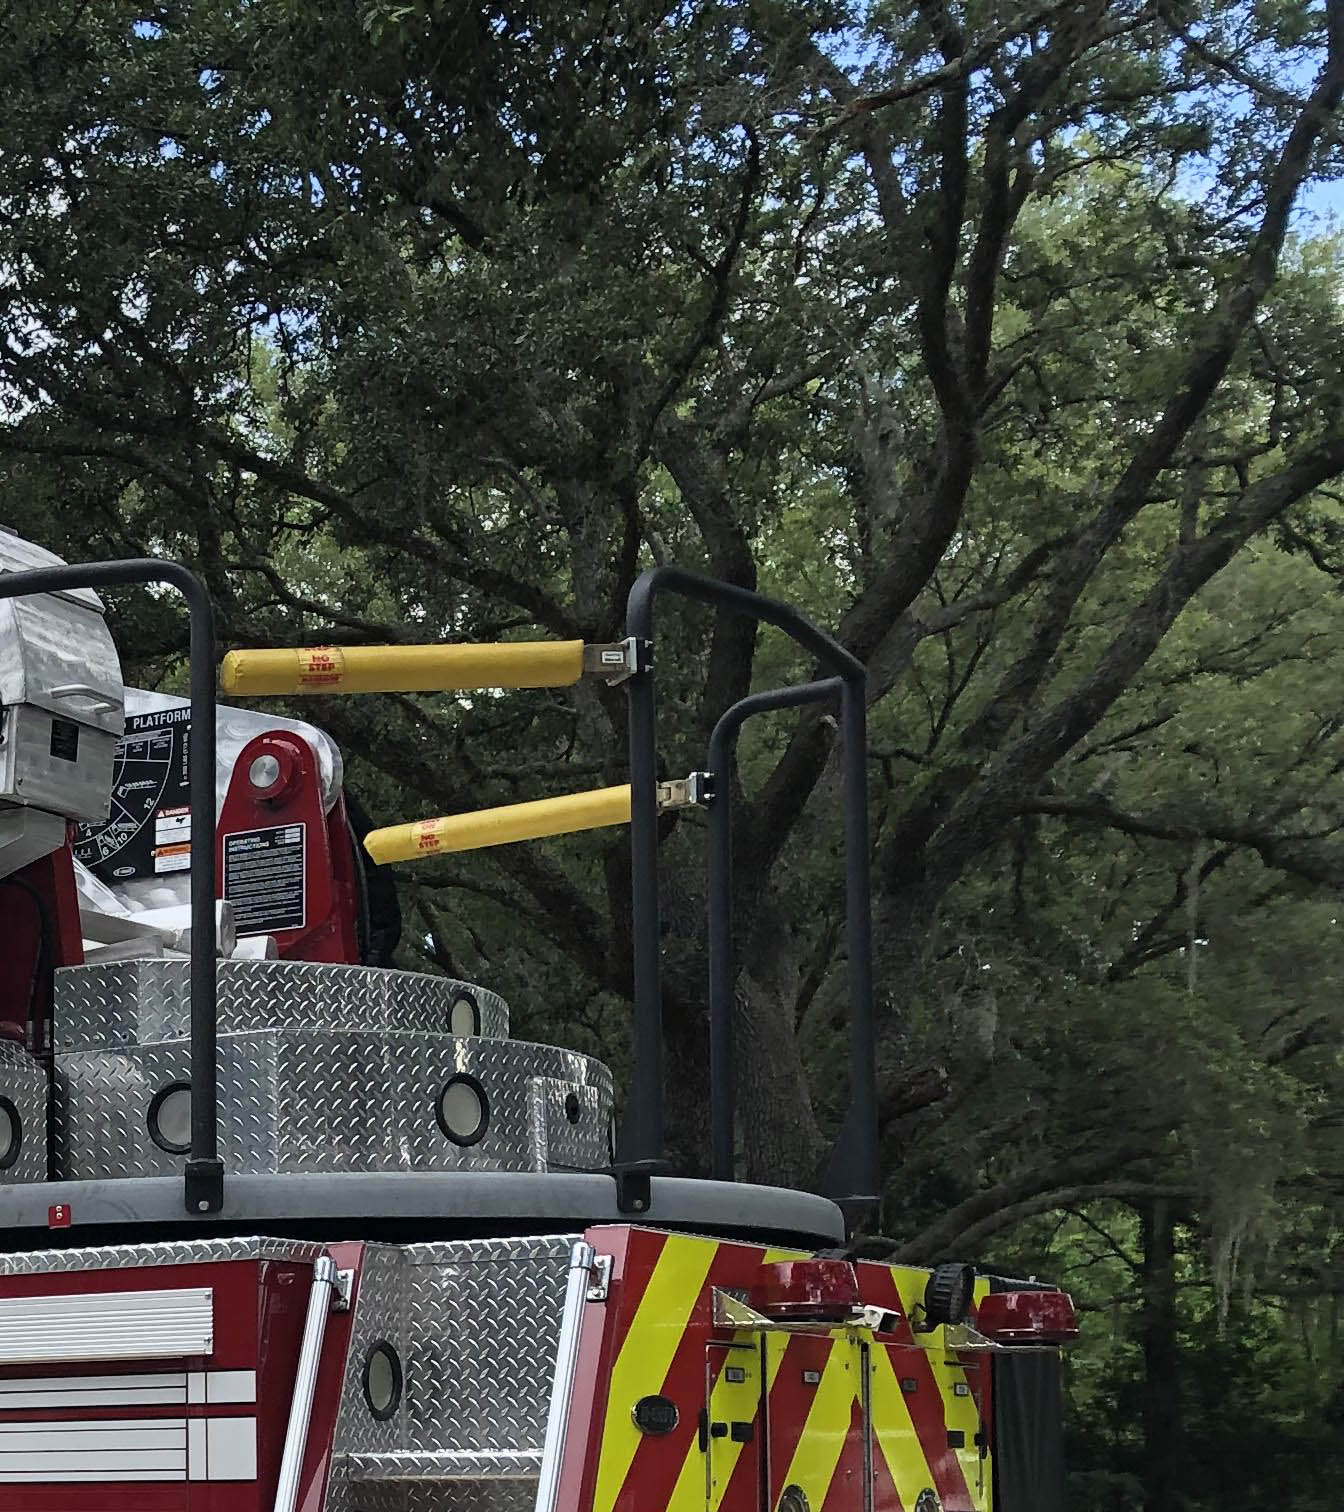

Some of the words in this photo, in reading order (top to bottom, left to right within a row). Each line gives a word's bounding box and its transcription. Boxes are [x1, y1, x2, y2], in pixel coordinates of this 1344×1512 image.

[133, 708, 191, 730] PLATFORM
[143, 797, 155, 811] 12
[116, 832, 128, 844] 10
[102, 846, 110, 856] 6
